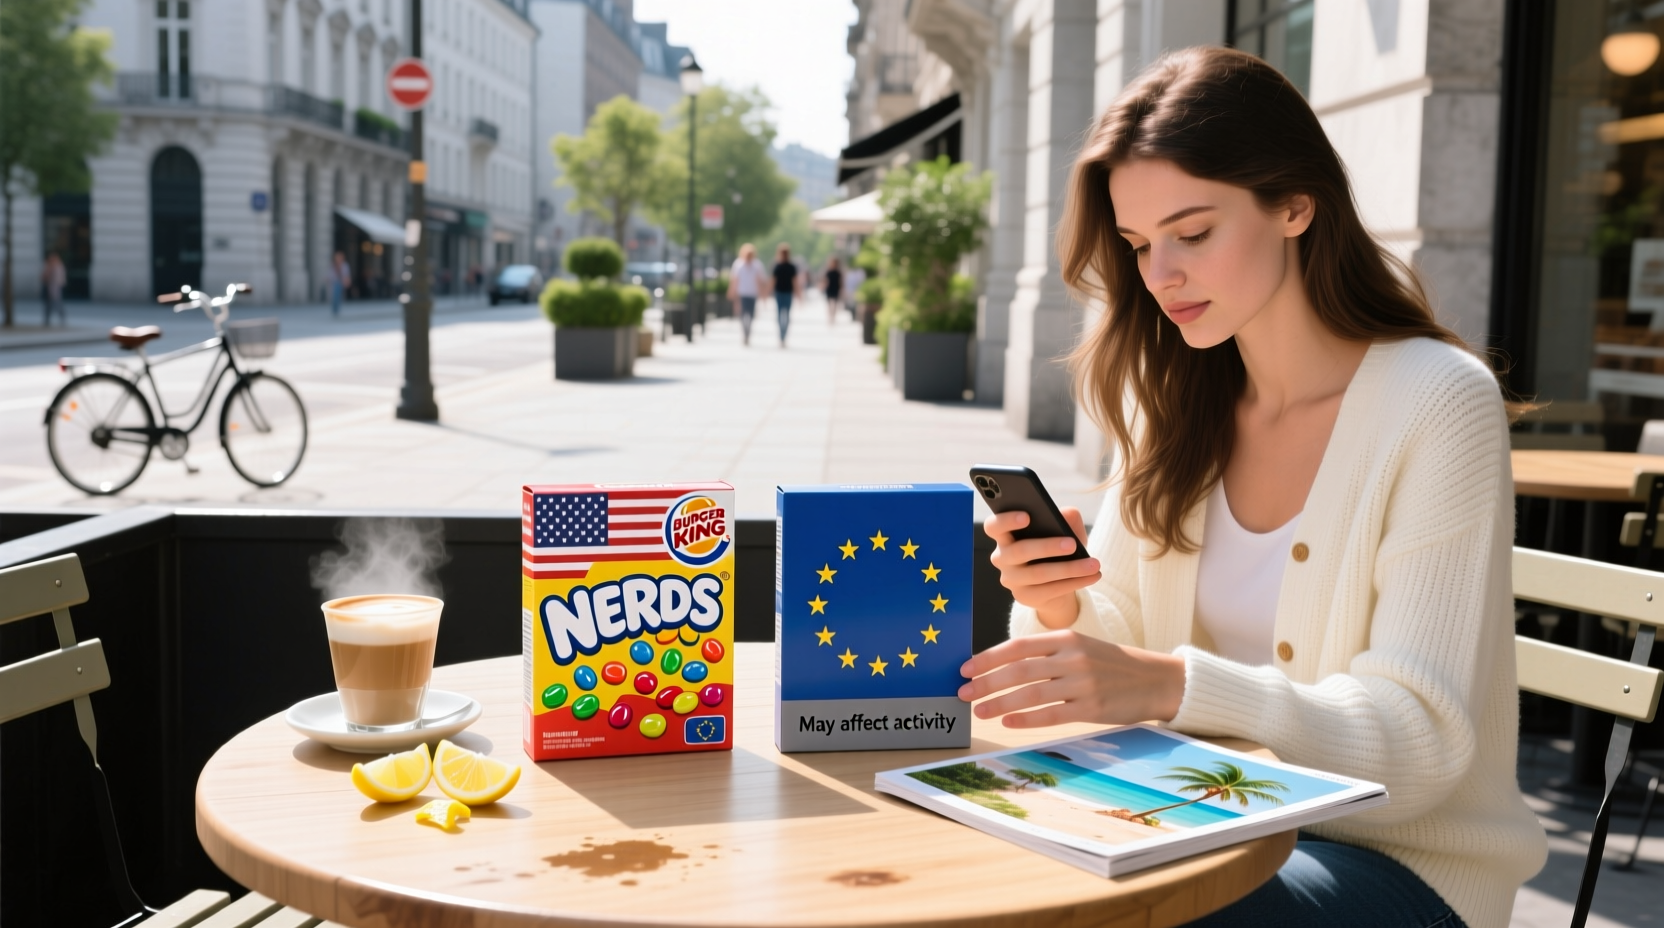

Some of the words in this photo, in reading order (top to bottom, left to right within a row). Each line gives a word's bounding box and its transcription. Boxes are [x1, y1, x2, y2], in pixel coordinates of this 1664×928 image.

[674, 519, 726, 549] KING
[544, 576, 721, 660] NERDS
[799, 715, 835, 736] May
[840, 713, 889, 732] affect
[893, 712, 957, 734] activity
